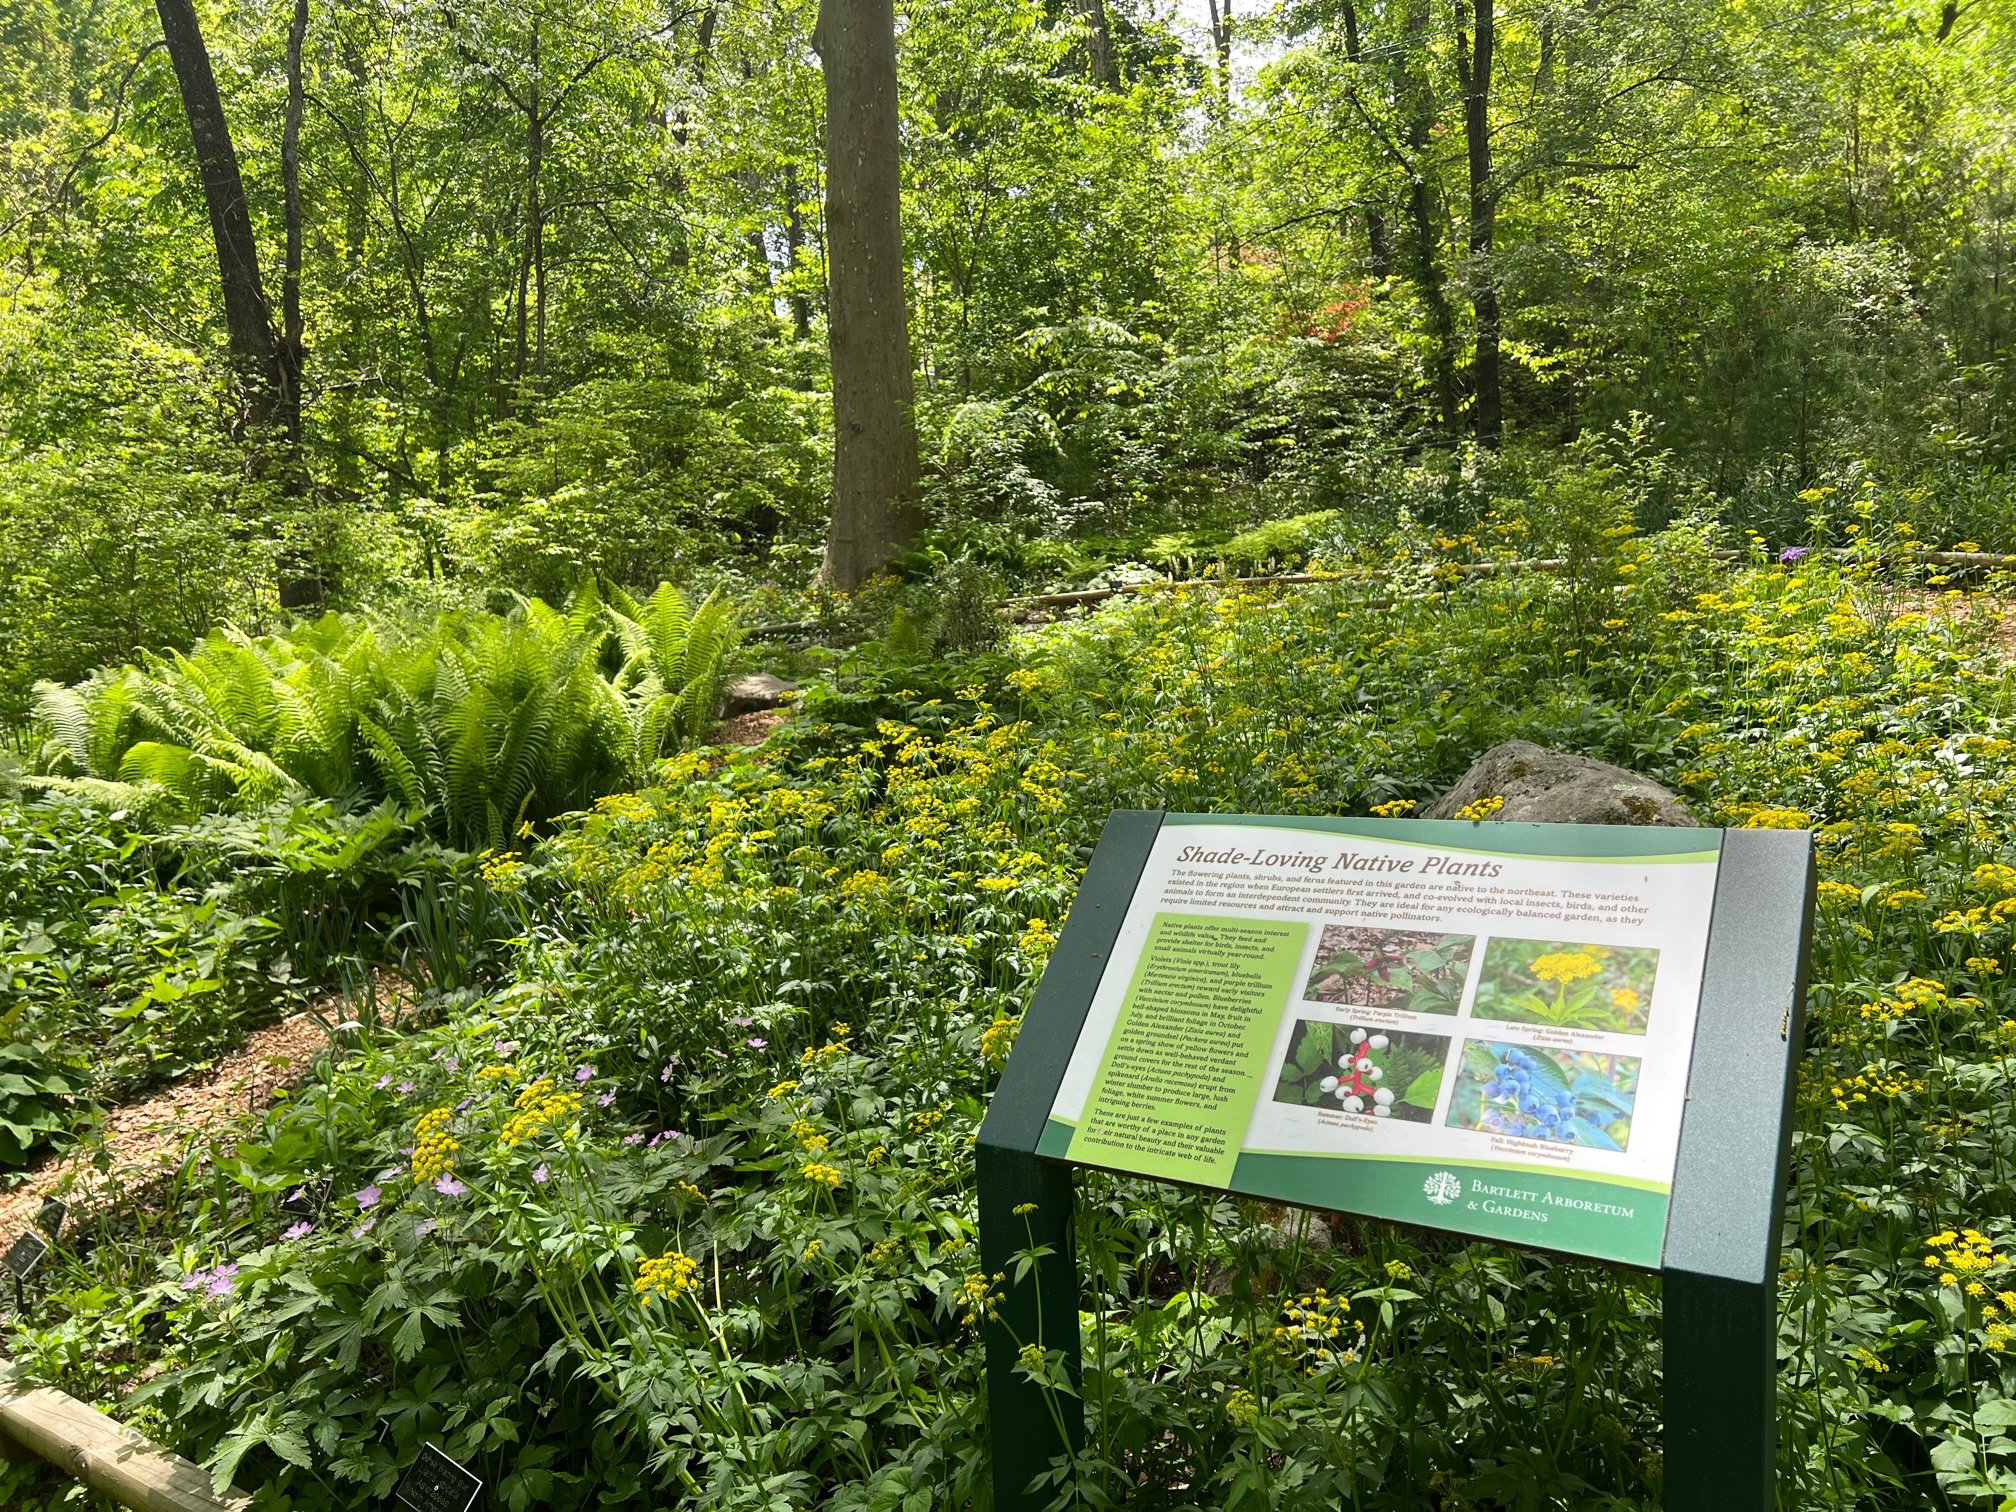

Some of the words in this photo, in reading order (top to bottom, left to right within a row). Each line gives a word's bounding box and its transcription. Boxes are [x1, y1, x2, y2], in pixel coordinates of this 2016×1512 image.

[1176, 845, 1328, 872] Shade-Loving
[1331, 852, 1414, 872] Native
[1418, 856, 1502, 877] Plants
[1187, 869, 1224, 880] flowering
[1224, 872, 1251, 880] plants,
[1253, 873, 1283, 882] shrubs,
[1326, 877, 1363, 885] featured
[1393, 881, 1426, 889] garden
[1445, 883, 1474, 892] native
[1489, 886, 1504, 894] the
[1507, 888, 1556, 897] northeast.
[1560, 890, 1591, 899] These
[1594, 893, 1638, 901] varieties
[1219, 881, 1245, 890] region
[1247, 882, 1269, 890] when
[1270, 883, 1310, 893] European
[1312, 886, 1344, 894] settlers
[1345, 888, 1364, 896] first
[1365, 889, 1400, 899] arrived,
[1422, 894, 1473, 902] co-evolved
[1476, 896, 1497, 904] with
[1499, 897, 1523, 905] local
[1525, 898, 1562, 909] insects,
[1565, 900, 1594, 911] birds,
[1597, 903, 1617, 911] and
[1620, 904, 1648, 913] other
[1160, 896, 1188, 904] require
[1189, 897, 1217, 906] limited
[1218, 901, 1257, 909] resources
[1276, 904, 1304, 912] attract
[1324, 908, 1359, 916] support
[1360, 910, 1388, 918] native
[1389, 911, 1441, 921] pollinators.
[1163, 887, 1194, 895] animals
[1204, 889, 1224, 897] form
[1237, 891, 1300, 902] interdependent
[1354, 898, 1378, 908] They
[1396, 901, 1419, 909] ideal
[1420, 902, 1435, 910] for
[1436, 905, 1454, 913] any
[1456, 906, 1514, 917] ecologically
[1515, 908, 1561, 919] balanced
[1563, 913, 1602, 922] garden,
[1620, 915, 1643, 926] they
[1181, 938, 1203, 946] shelter
[1220, 926, 1262, 934] multi-season
[1198, 948, 1226, 957] virtually
[1131, 1002, 1169, 1012] bell-shaped
[1169, 1006, 1200, 1016] blossoms
[1226, 1013, 1242, 1021] fruit
[1104, 1078, 1126, 1087] winter
[1126, 1081, 1154, 1091] slumber
[1161, 1087, 1191, 1096] produce
[1212, 1093, 1228, 1102] lush
[1090, 1117, 1104, 1125] that
[1117, 1122, 1141, 1132] worthy
[1156, 1128, 1176, 1137] place
[1185, 1134, 1199, 1142] any
[1199, 1136, 1225, 1145] garden
[1094, 1107, 1114, 1117] These
[1125, 1112, 1140, 1121] just
[1146, 1116, 1159, 1124] few
[1160, 1120, 1193, 1129] examples
[1203, 1125, 1226, 1135] plants
[1083, 1136, 1124, 1148] contribution
[1134, 1143, 1145, 1151] the
[1146, 1145, 1176, 1156] intricate
[1086, 1125, 1097, 1133] for
[1097, 1128, 1113, 1136] teir
[1113, 1131, 1138, 1140] natural
[1138, 1134, 1162, 1145] beauty
[1162, 1139, 1176, 1147] and
[1177, 1141, 1194, 1149] their
[1195, 1144, 1224, 1155] valuable
